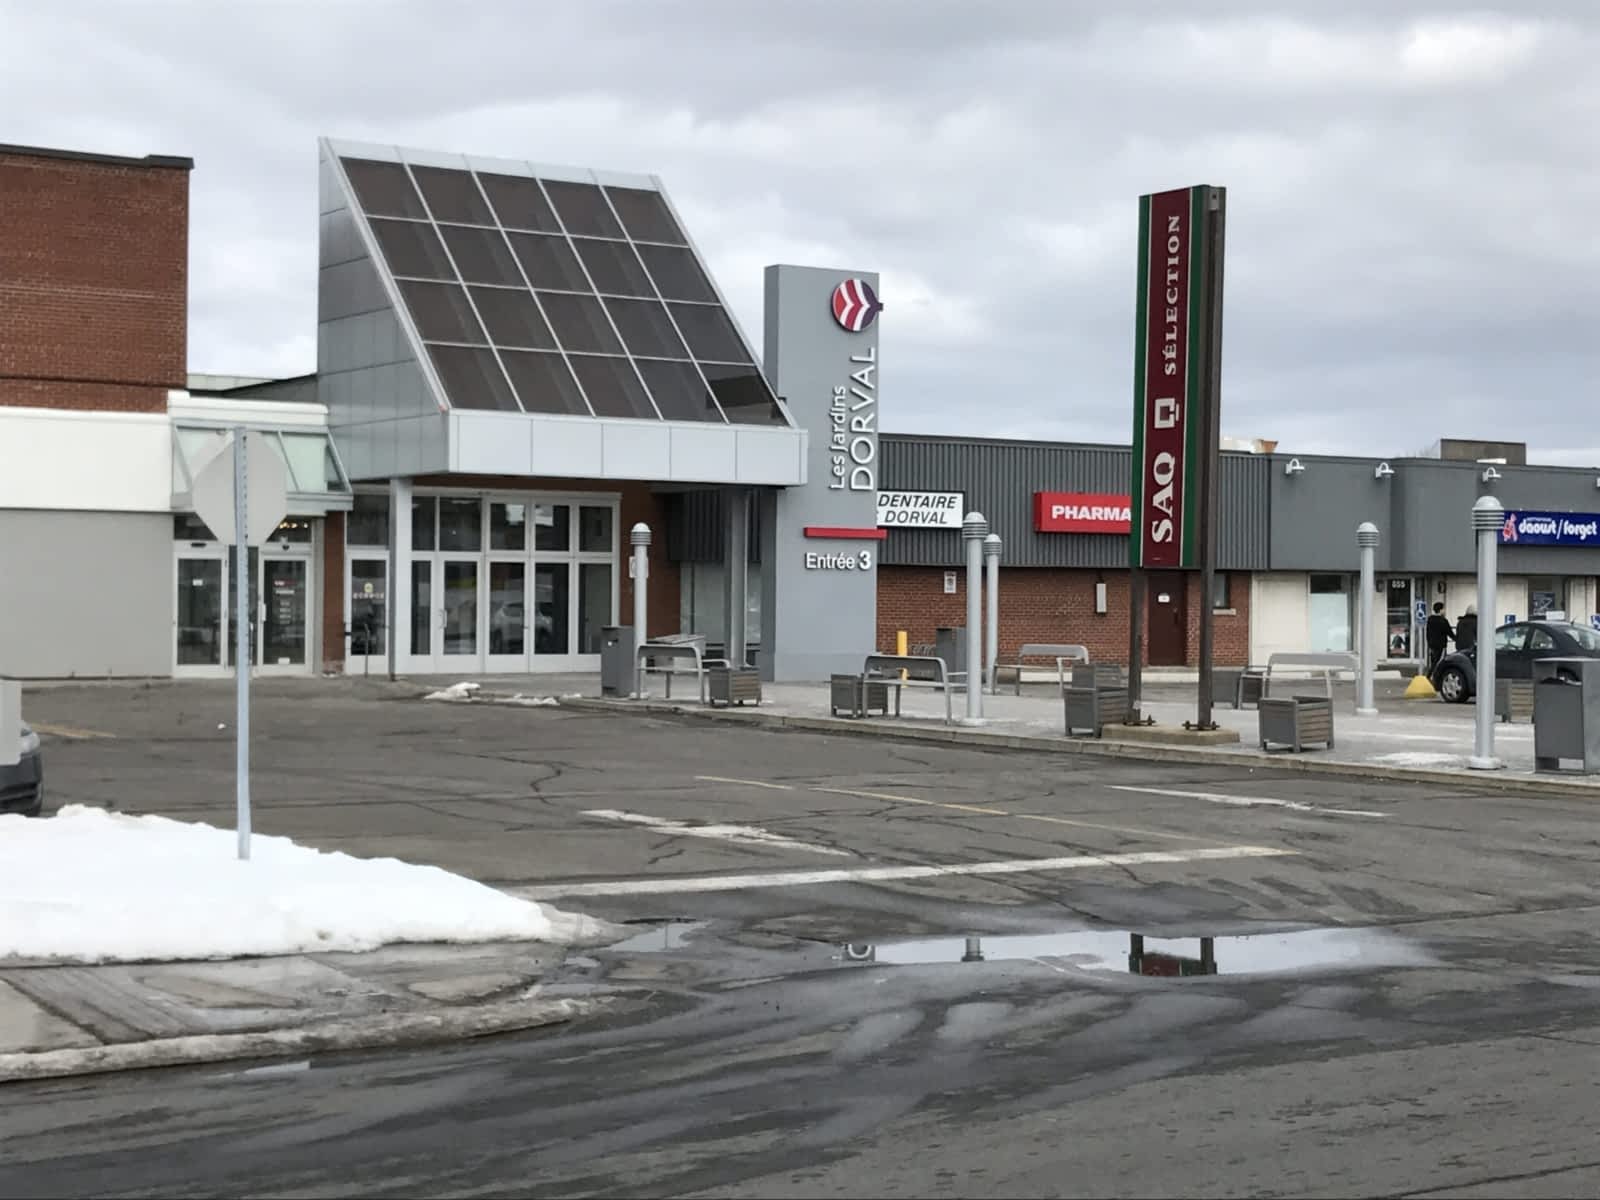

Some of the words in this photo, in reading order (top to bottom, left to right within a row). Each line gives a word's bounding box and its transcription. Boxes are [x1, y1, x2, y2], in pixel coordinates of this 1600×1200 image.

[1162, 215, 1180, 375] SÉLECTION
[829, 385, 849, 452] Jardins
[850, 347, 876, 491] DORVAL
[830, 455, 846, 489] Les
[878, 494, 958, 509] DENTAIRE
[884, 510, 948, 525] DORVAL
[1151, 452, 1175, 543] SAQ
[806, 552, 855, 570] Entrée
[859, 550, 872, 570] 3
